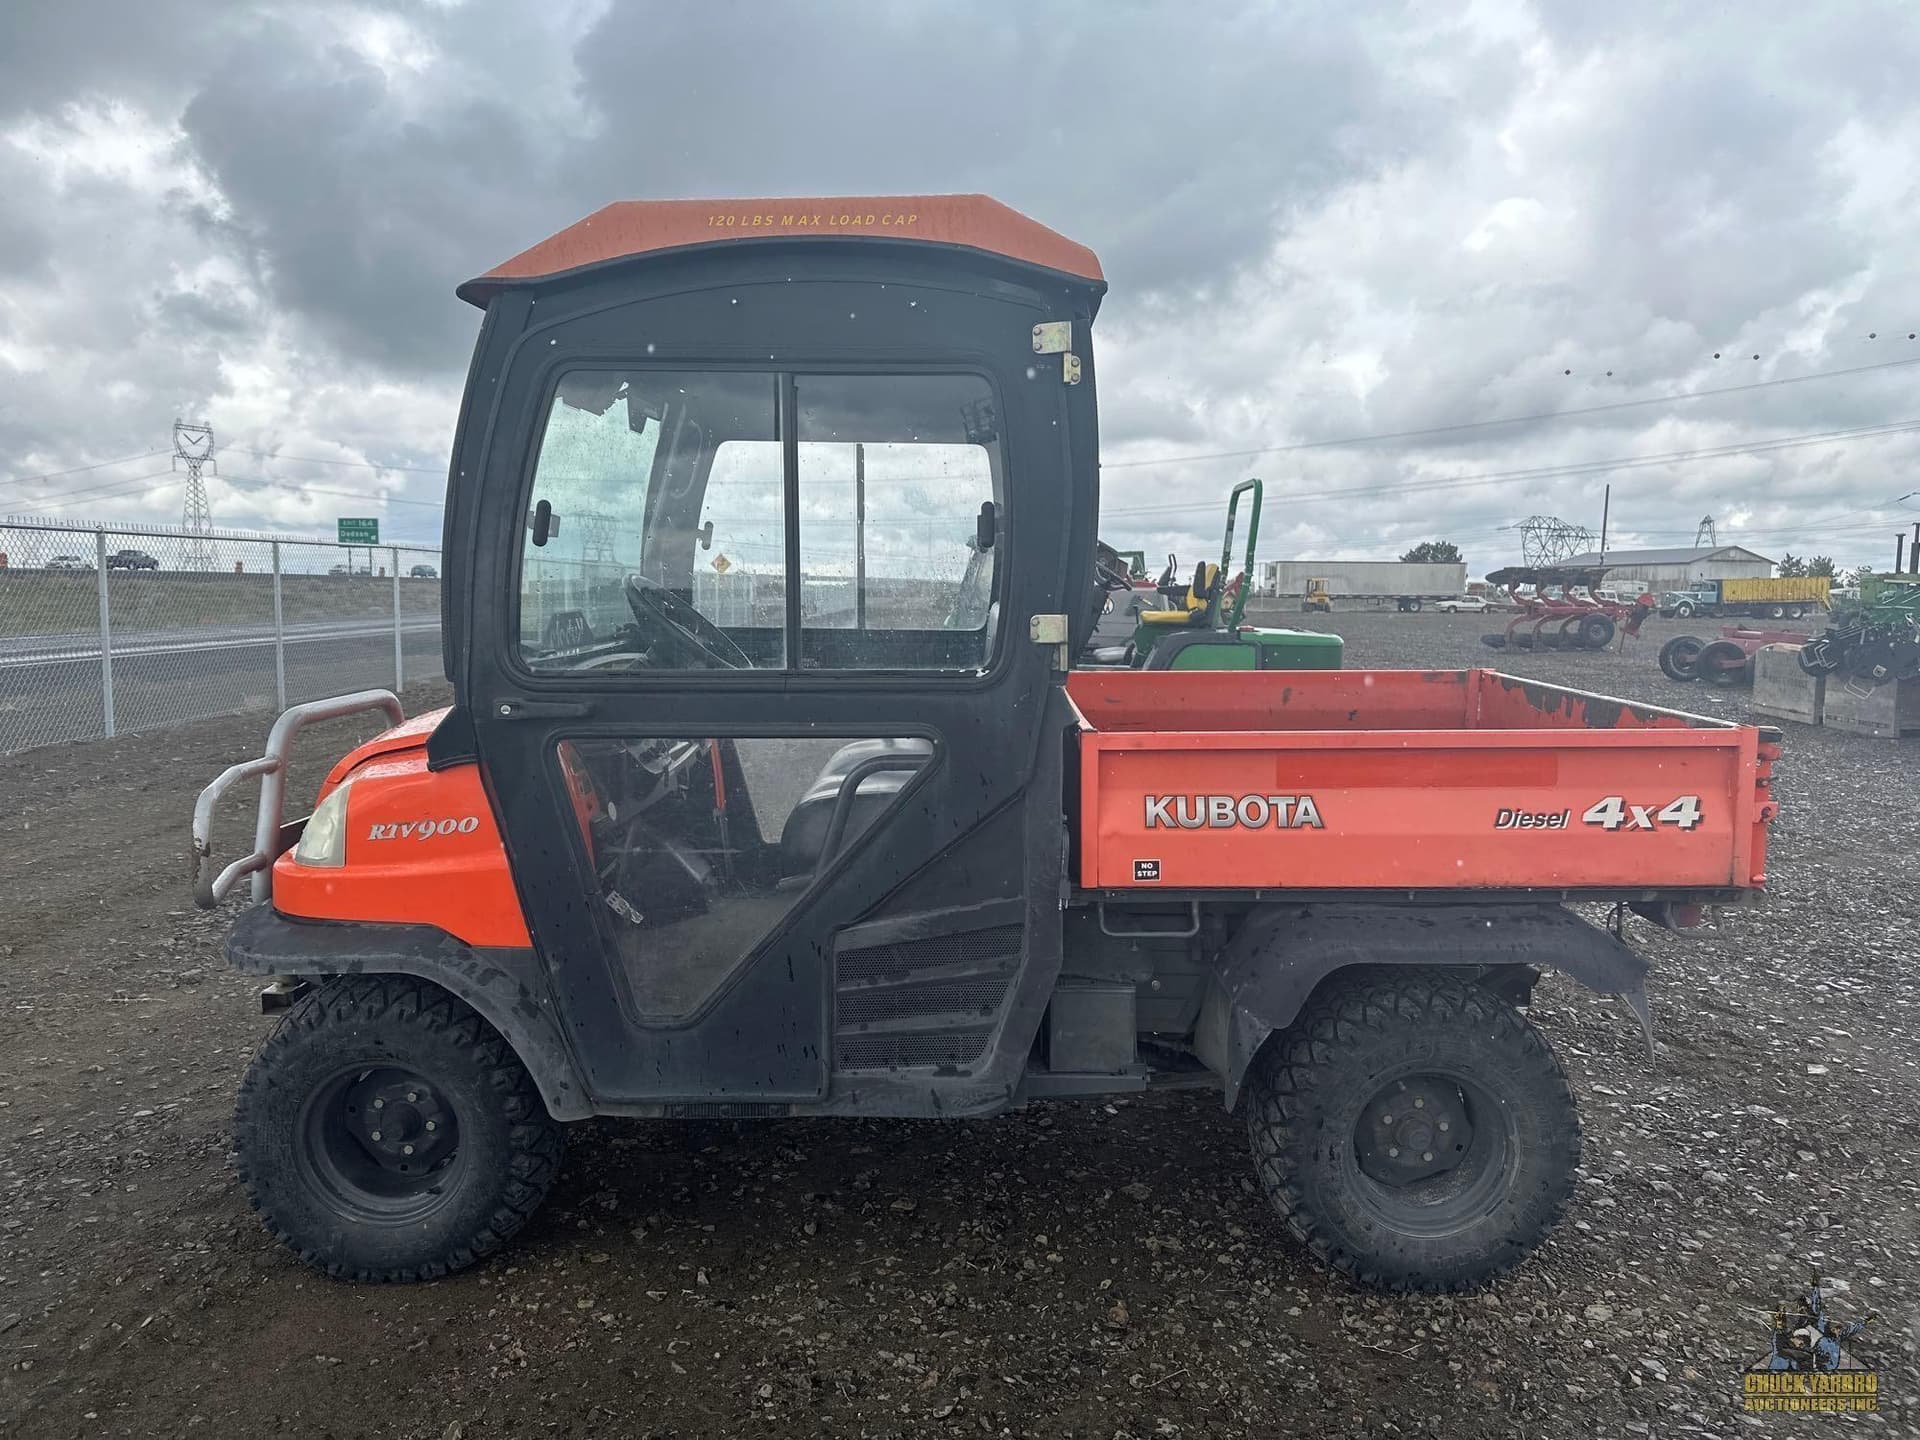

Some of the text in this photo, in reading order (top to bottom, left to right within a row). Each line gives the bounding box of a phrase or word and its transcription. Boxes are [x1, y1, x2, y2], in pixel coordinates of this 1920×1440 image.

[707, 214, 918, 226] 120 LBS MAX LOAD CAP
[1145, 794, 1325, 829] KUBOTA
[1494, 795, 1704, 832] Diesel 4x4
[367, 816, 479, 841] RTV900
